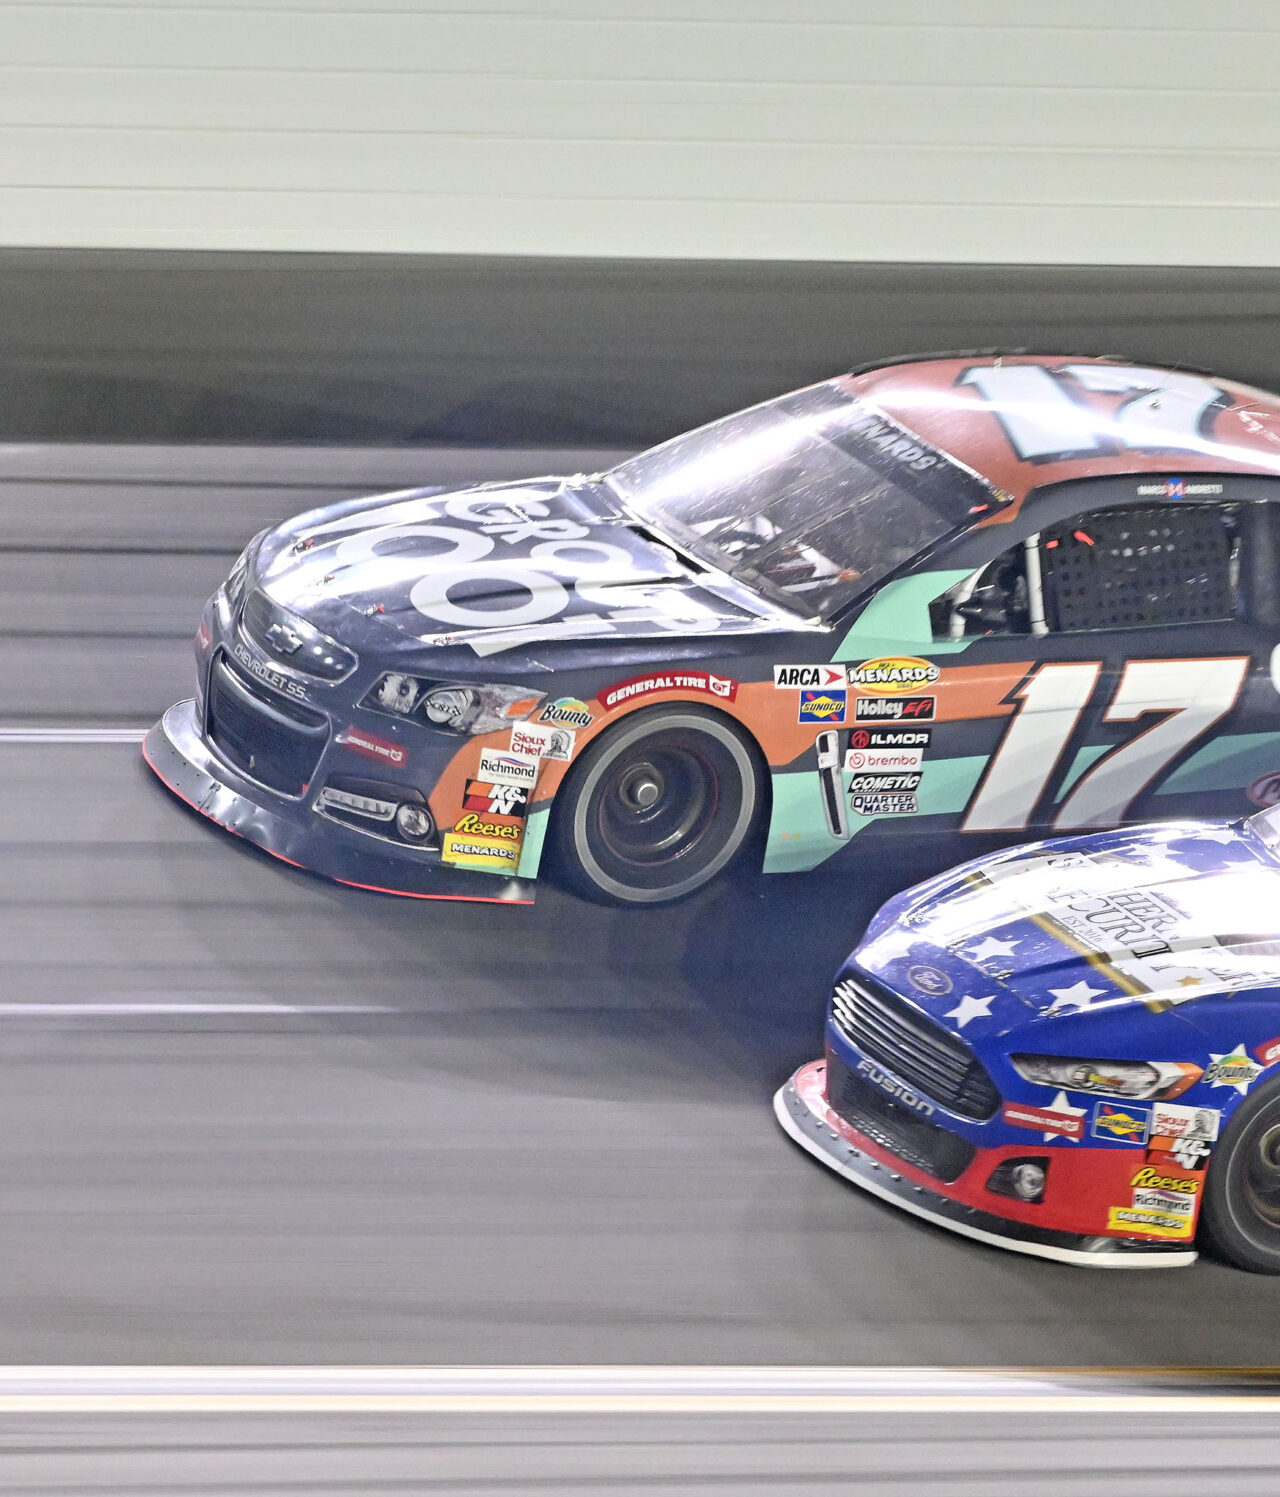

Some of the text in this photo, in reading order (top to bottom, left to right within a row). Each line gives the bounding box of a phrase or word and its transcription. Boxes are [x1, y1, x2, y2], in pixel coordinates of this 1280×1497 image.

[955, 363, 1230, 460] 17
[234, 644, 308, 700] CHEVROLET SS
[777, 668, 821, 686] ARCA
[848, 666, 940, 684] MENARDS
[606, 676, 673, 706] GENERAL
[673, 676, 706, 688] TIRE
[539, 702, 594, 729] Bounty
[802, 702, 845, 712] SUNOCO
[857, 700, 903, 718] Holley
[513, 732, 546, 746] Sioux
[870, 733, 929, 745] ILMOR
[961, 655, 1250, 834] 17
[511, 743, 542, 756] Chief
[480, 759, 536, 778] Richmond
[868, 754, 918, 766] brembo
[851, 774, 921, 790] COMETIC
[853, 796, 913, 809] QUARTER
[863, 802, 916, 814] MASTER
[454, 813, 522, 839] Reese's
[451, 842, 517, 860] MENARDS
[857, 1060, 937, 1117] FUSION
[1130, 1167, 1201, 1194] Reese's
